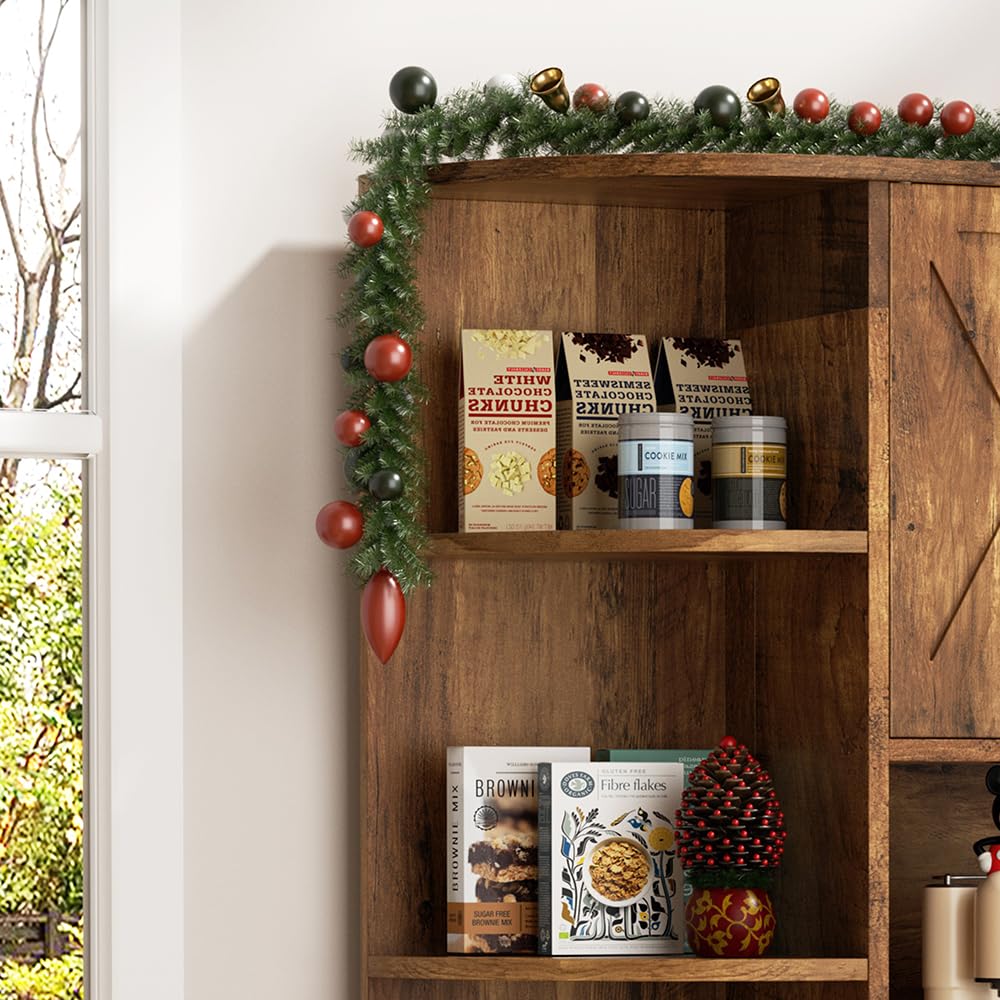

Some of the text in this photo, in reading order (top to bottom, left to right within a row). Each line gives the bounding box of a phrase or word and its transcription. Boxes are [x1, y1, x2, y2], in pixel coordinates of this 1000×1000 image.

[644, 451, 675, 460] COOKIE
[676, 452, 688, 460] MIX
[747, 454, 778, 464] COOKIE
[624, 477, 657, 510] SUGAR
[475, 779, 535, 798] BROWNI
[601, 778, 667, 791] Fibre flakes
[473, 910, 511, 918] SUGAR FREE
[472, 919, 500, 927] BROWNIE
